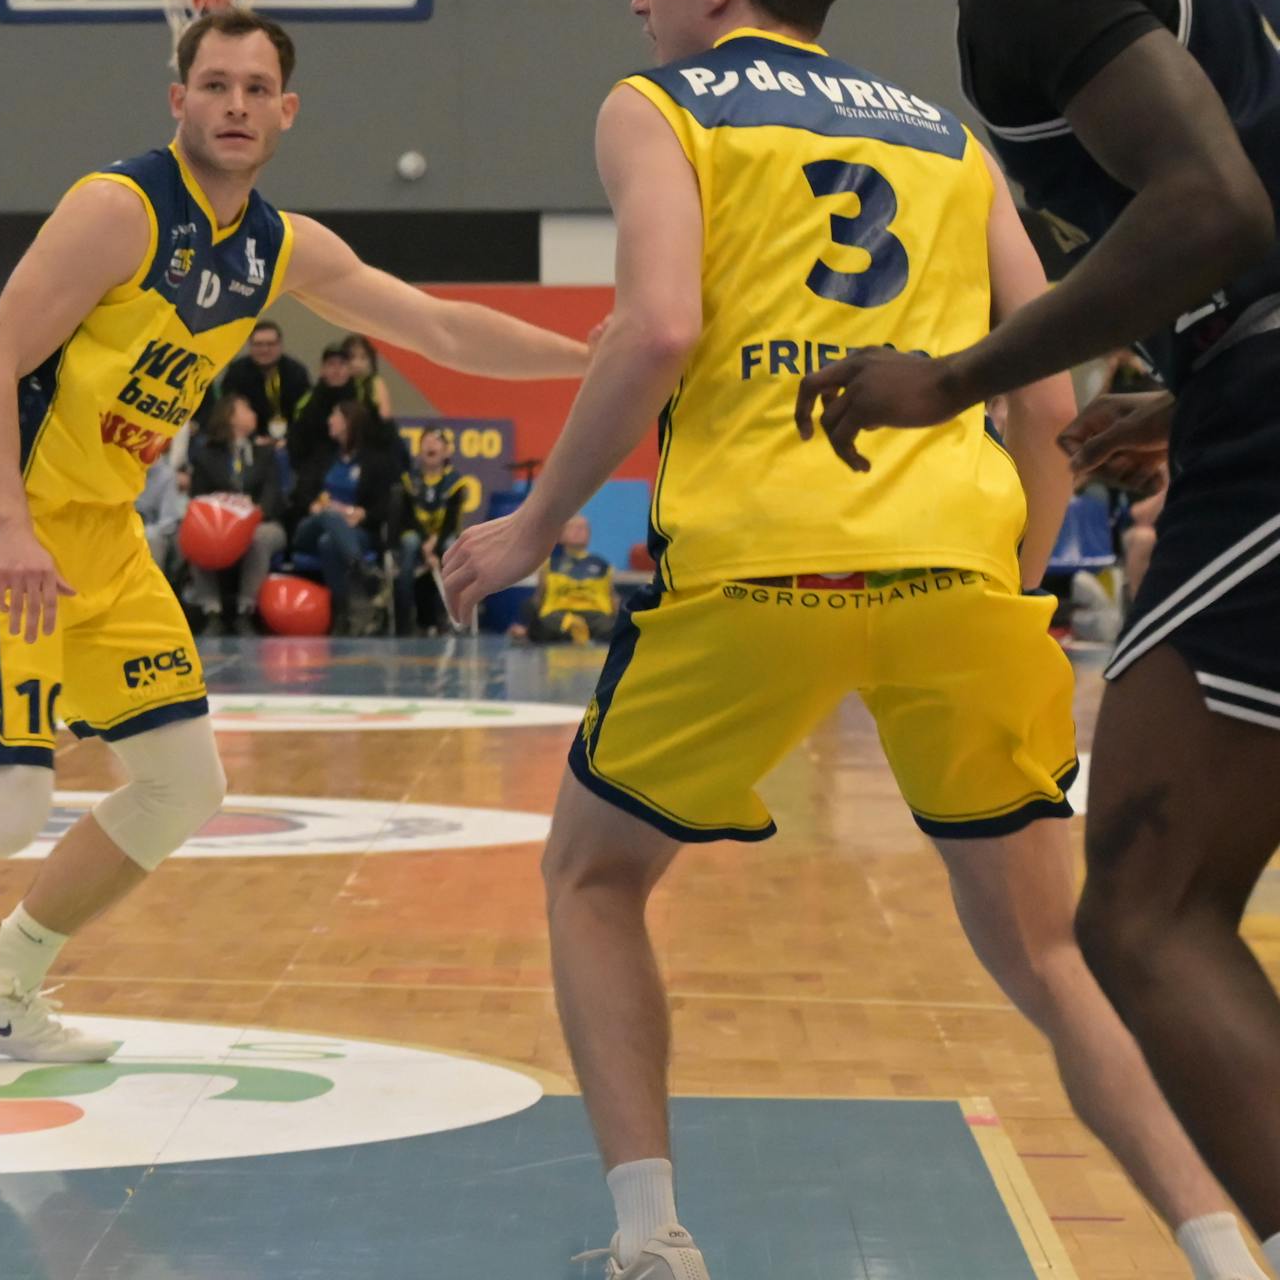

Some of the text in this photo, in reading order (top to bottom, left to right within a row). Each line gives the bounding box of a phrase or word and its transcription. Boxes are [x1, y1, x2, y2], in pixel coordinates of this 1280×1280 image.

[679, 60, 941, 121] PJ de VRIES
[802, 159, 909, 308] 3
[752, 568, 992, 609] GROOTHANDEL
